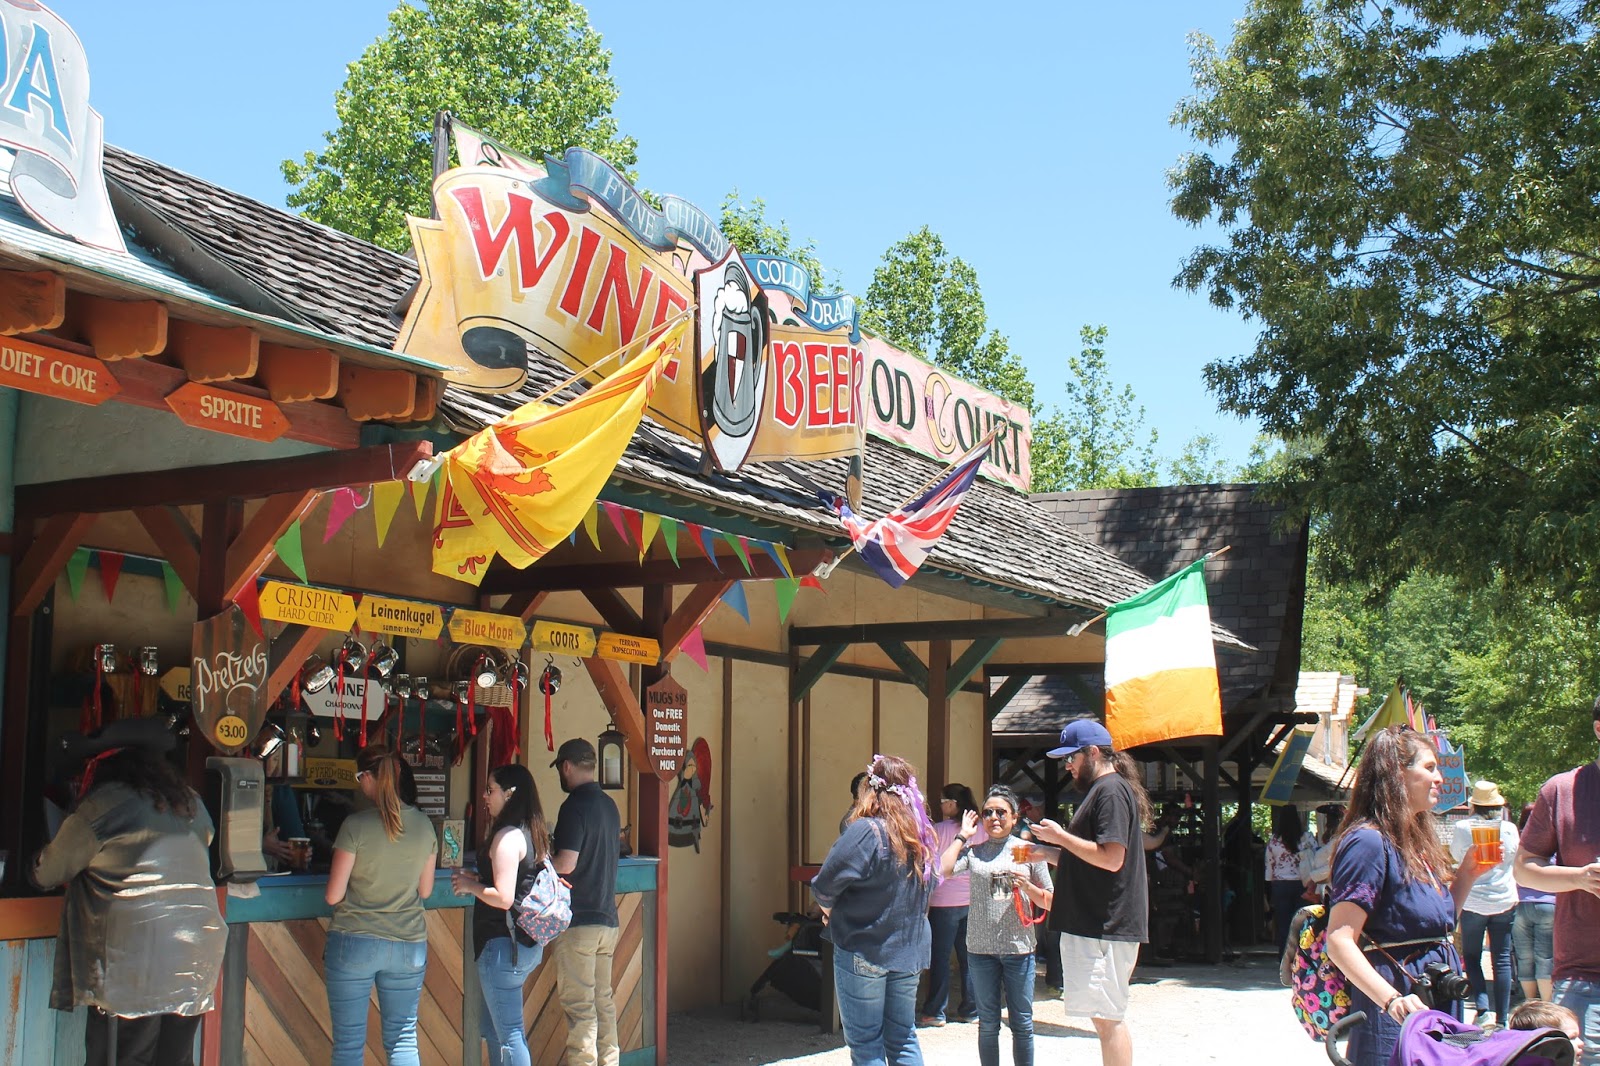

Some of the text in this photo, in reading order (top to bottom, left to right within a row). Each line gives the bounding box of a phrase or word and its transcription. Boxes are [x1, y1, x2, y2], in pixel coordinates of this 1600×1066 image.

[600, 175, 723, 258] FYNE CHILLED
[756, 260, 804, 290] COLD
[1, 346, 97, 393] DIET COKE
[772, 340, 865, 432] BEER
[200, 395, 262, 429] SPRITE
[871, 358, 1023, 475] OD COURT
[275, 586, 341, 613] CRISPIN
[278, 606, 335, 625] HARD CIDER
[371, 602, 435, 627] Leinenkugel
[464, 618, 487, 637] Blue
[550, 630, 580, 650] COORS
[649, 690, 673, 705] MUGS
[653, 708, 683, 719] One FREE
[220, 725, 246, 739] $3.00
[655, 721, 681, 732] Domestic
[654, 734, 682, 744] Beer with
[651, 747, 684, 757] Purchase of
[660, 760, 676, 771] MUG
